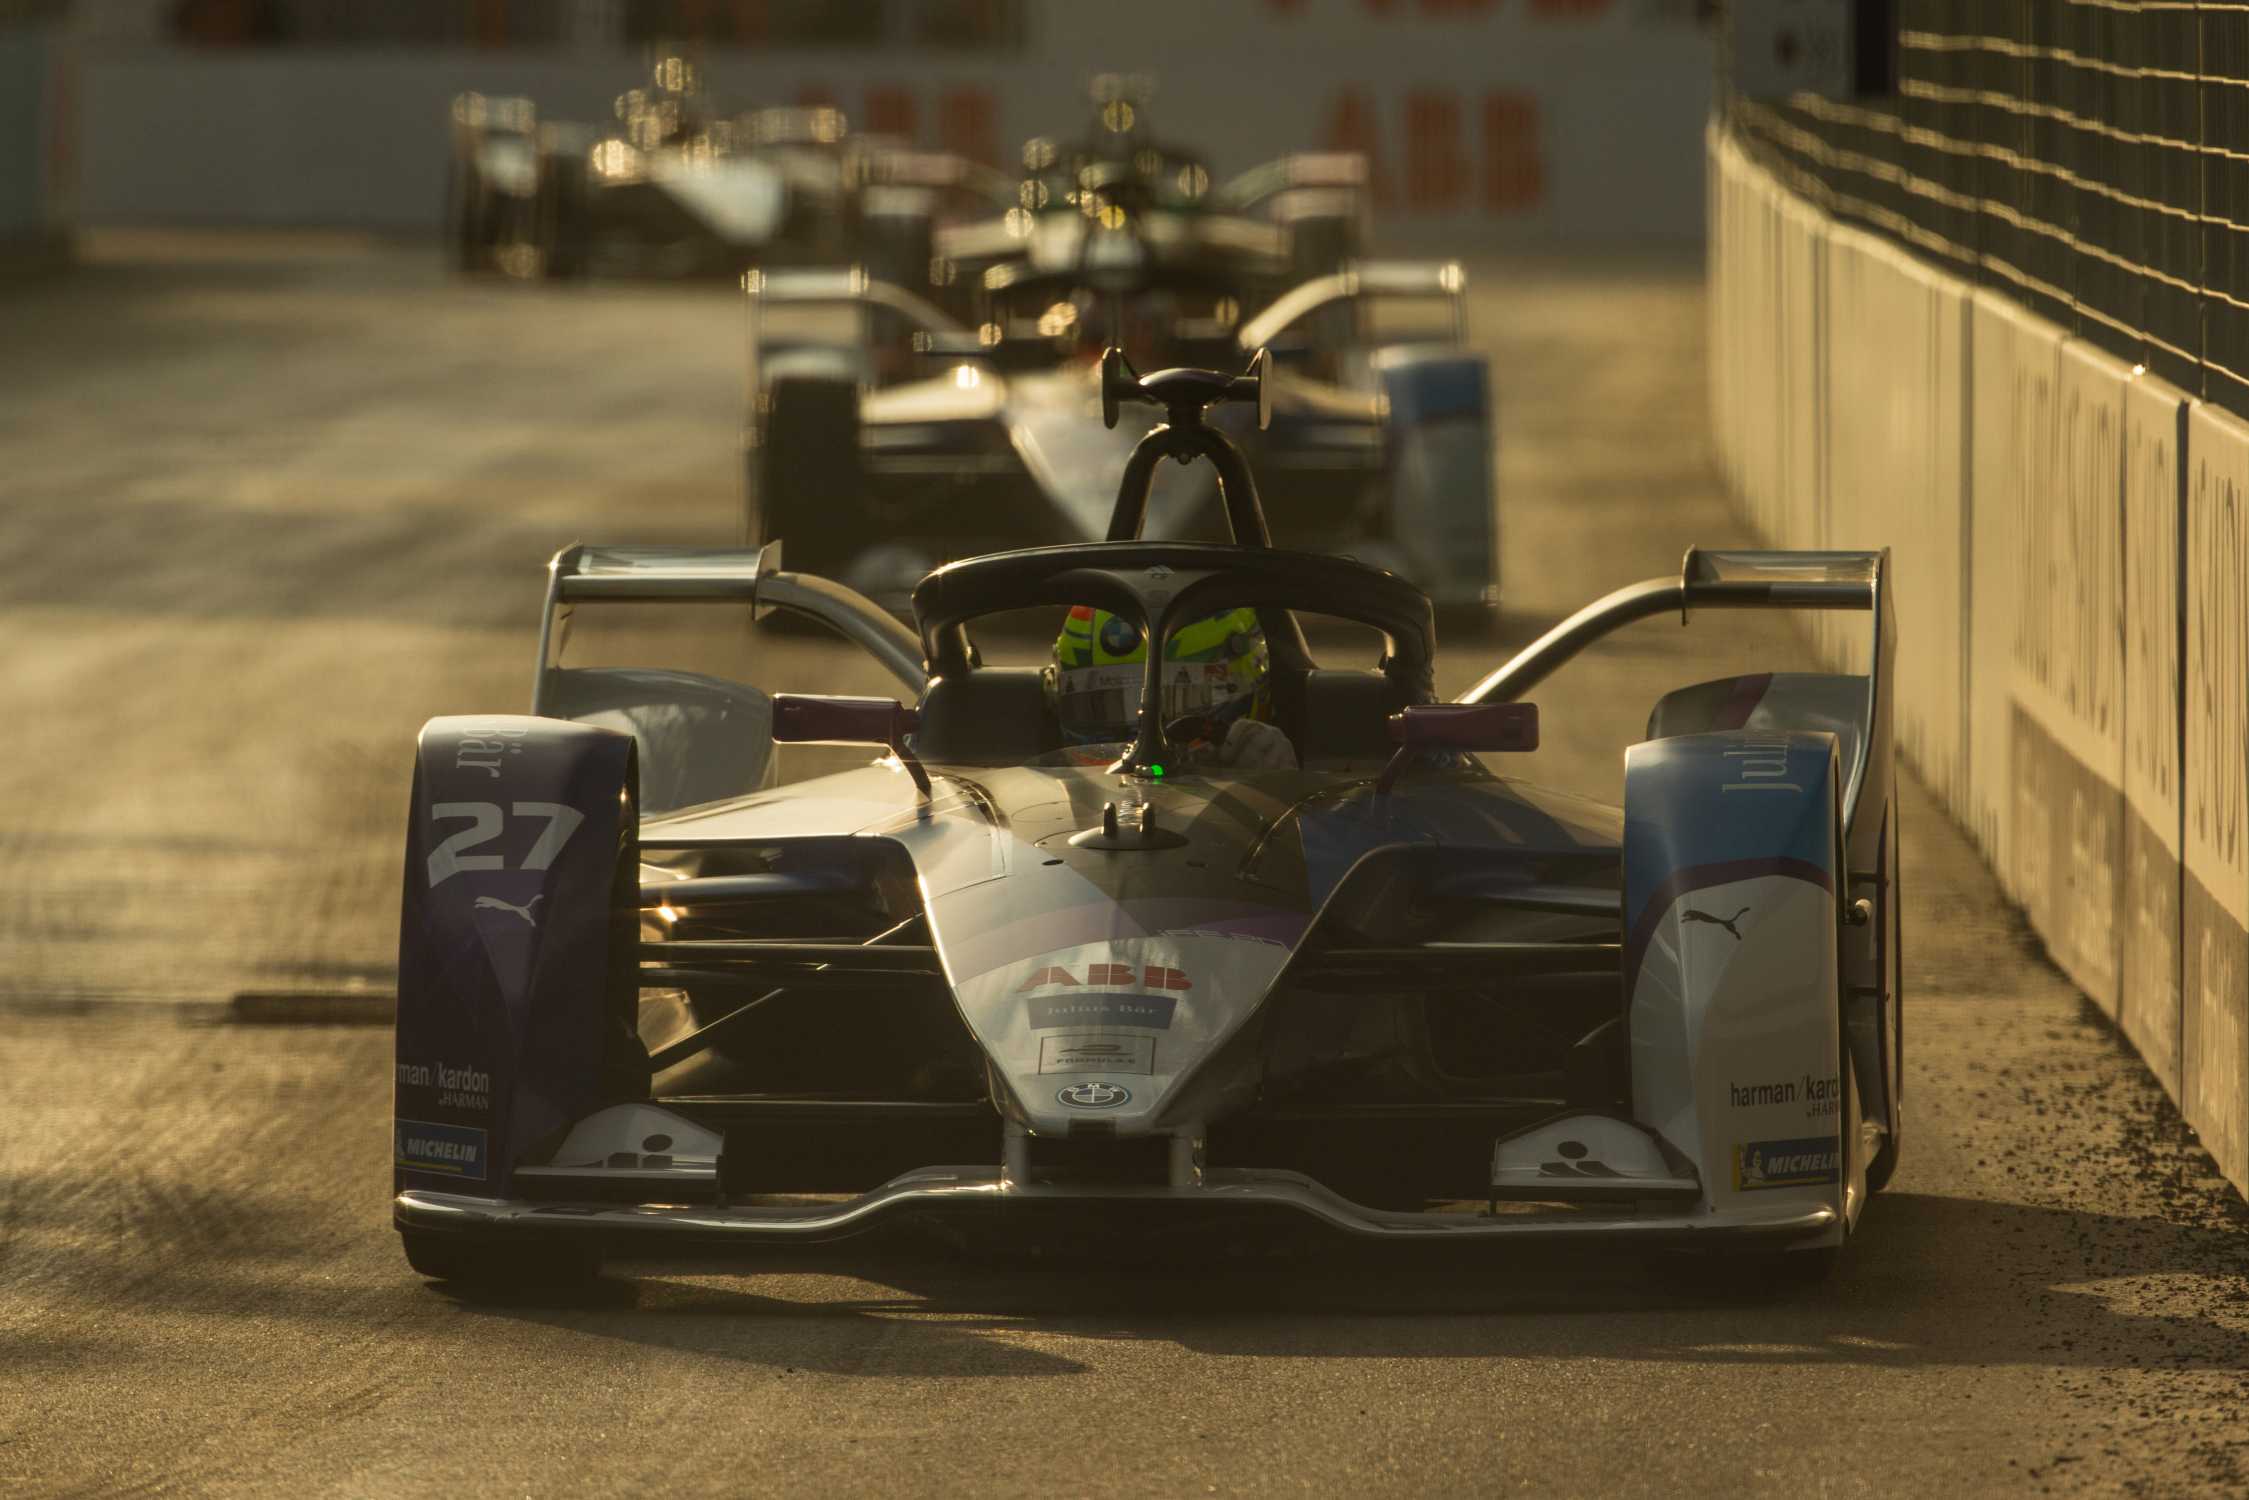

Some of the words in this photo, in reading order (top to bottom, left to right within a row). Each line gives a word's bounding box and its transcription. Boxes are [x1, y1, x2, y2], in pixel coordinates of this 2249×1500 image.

[427, 801, 585, 889] 27
[1015, 962, 1193, 993] ABB
[407, 1138, 478, 1162] MICHELIN
